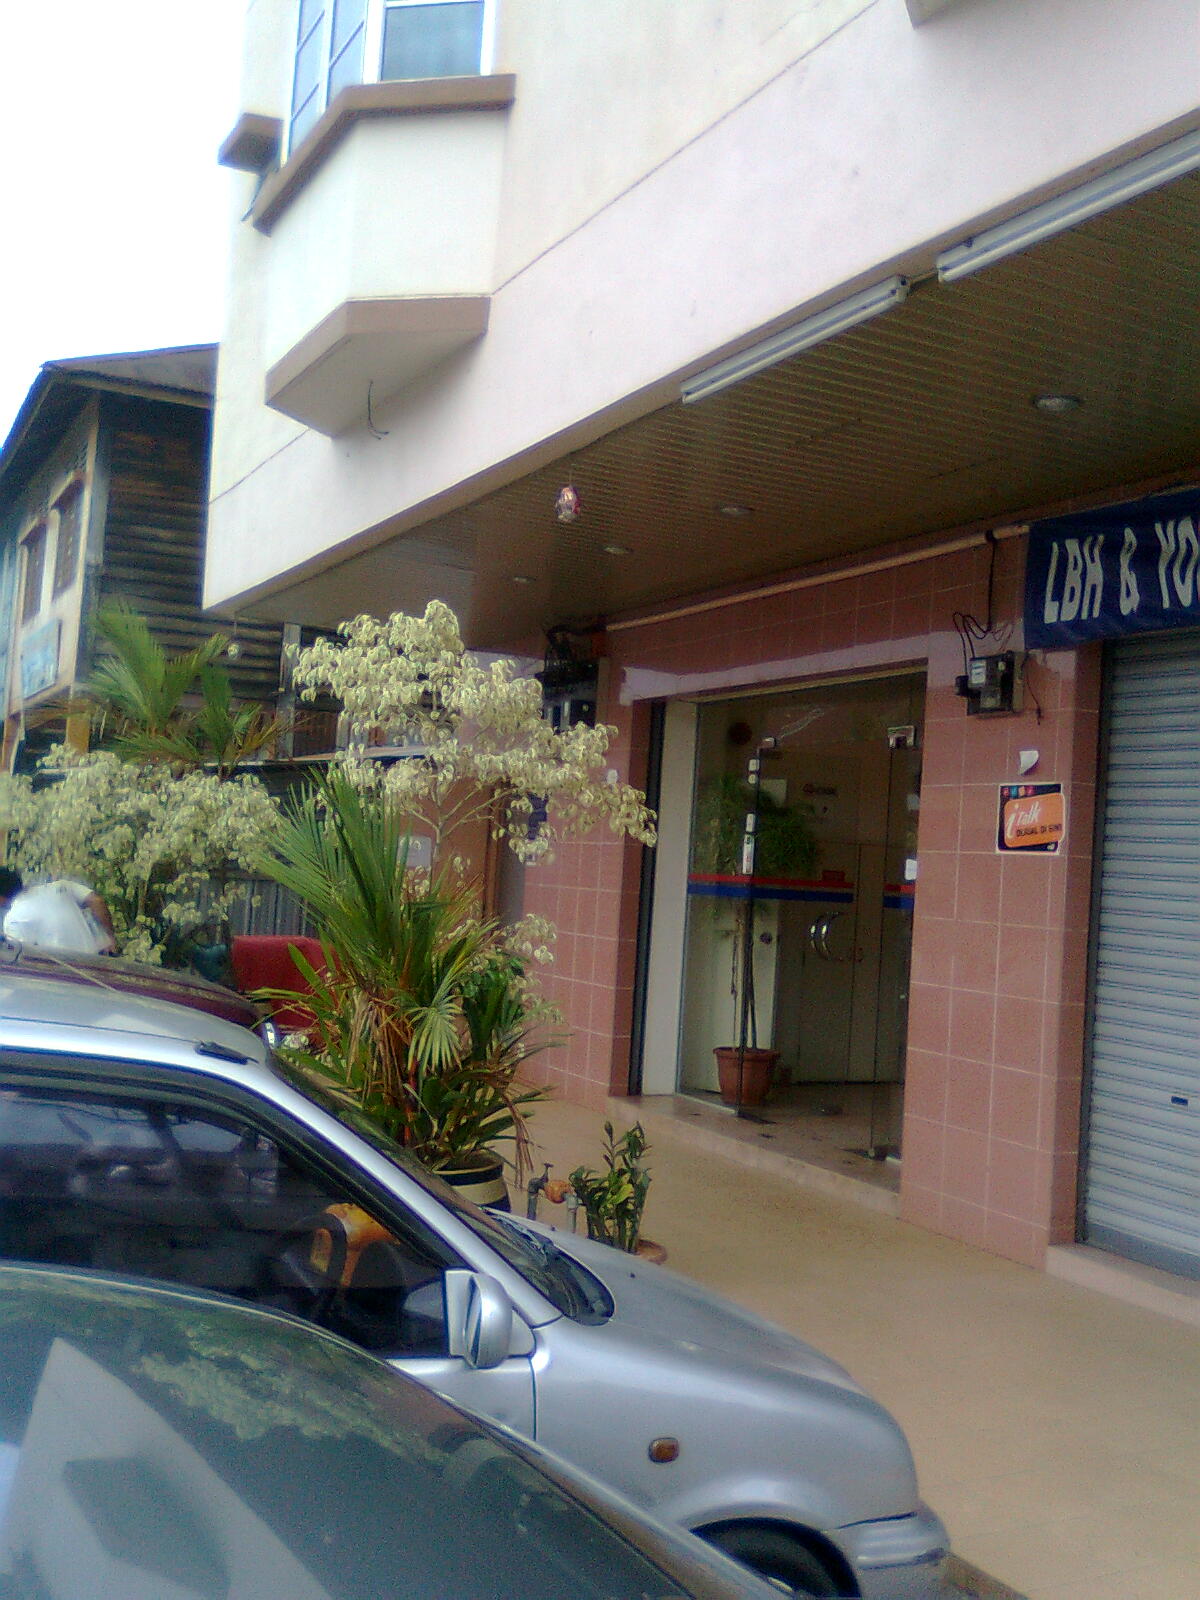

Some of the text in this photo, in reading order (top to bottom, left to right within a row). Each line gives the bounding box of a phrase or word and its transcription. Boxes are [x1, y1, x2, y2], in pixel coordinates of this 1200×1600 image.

[1044, 515, 1200, 624] LBH & YO
